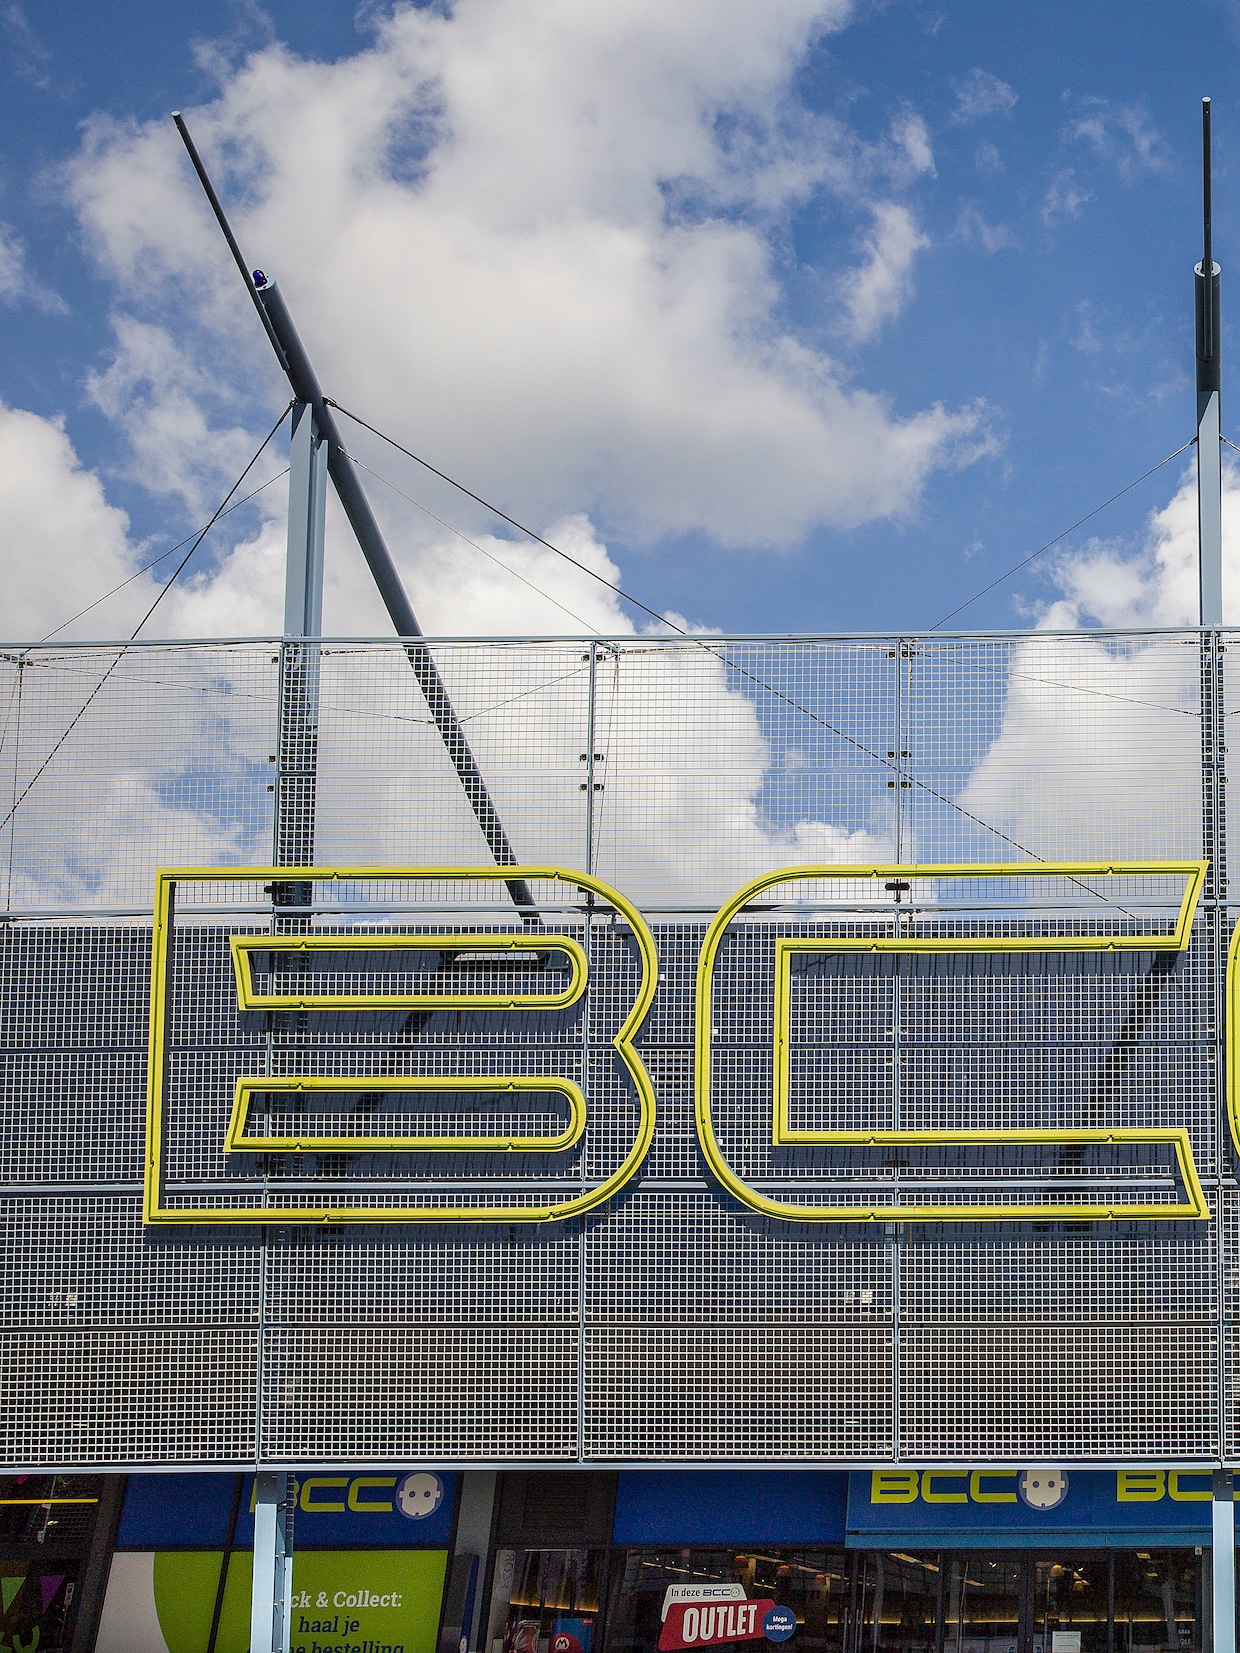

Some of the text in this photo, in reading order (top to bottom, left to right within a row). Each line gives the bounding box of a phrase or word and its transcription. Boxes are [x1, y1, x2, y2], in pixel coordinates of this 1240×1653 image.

[249, 1477, 397, 1513] CC
[870, 1470, 1018, 1504] BCC
[315, 1591, 329, 1608] &
[333, 1590, 403, 1608] Collect:
[671, 1588, 679, 1597] In
[681, 1588, 700, 1597] deze
[298, 1616, 360, 1637] haal je
[682, 1604, 758, 1643] OUTLET
